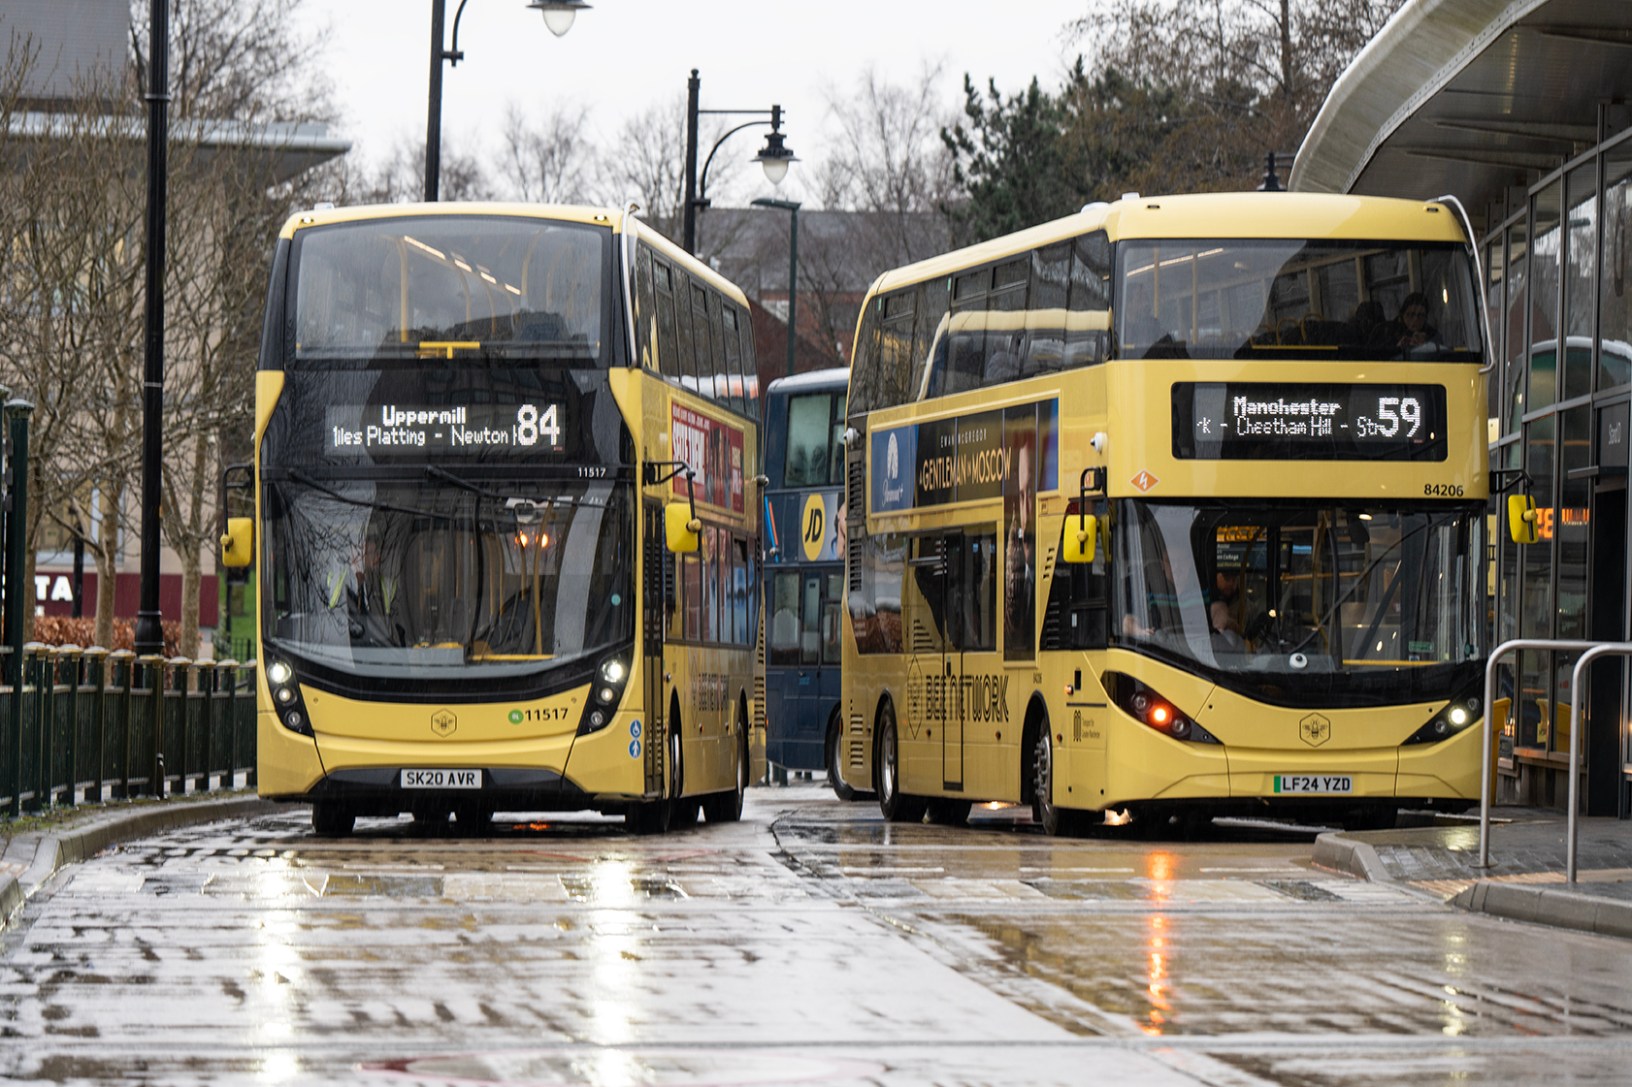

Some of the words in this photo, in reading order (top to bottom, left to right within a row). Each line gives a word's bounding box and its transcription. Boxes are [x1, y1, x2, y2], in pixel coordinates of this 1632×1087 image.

[382, 405, 467, 427] Uppermill
[1234, 396, 1342, 417] Manchester
[1379, 397, 1421, 438] 59
[366, 425, 426, 447] Platting
[451, 424, 509, 446] Newton
[518, 404, 560, 446] 84
[1236, 415, 1307, 437] Cheetham
[1310, 416, 1332, 437] Hill
[577, 466, 607, 478] 11517
[923, 453, 967, 492] GENTLEMAN
[972, 446, 1012, 485] MOSCOW
[1423, 483, 1464, 498] 84206
[804, 508, 823, 544] JD
[925, 674, 947, 721] BEE
[949, 673, 1009, 723] NETWORK
[525, 707, 569, 721] 11517
[406, 771, 444, 786] SK20
[447, 771, 475, 786] AVR
[1282, 777, 1320, 792] LF24
[1323, 777, 1351, 792] YZD
